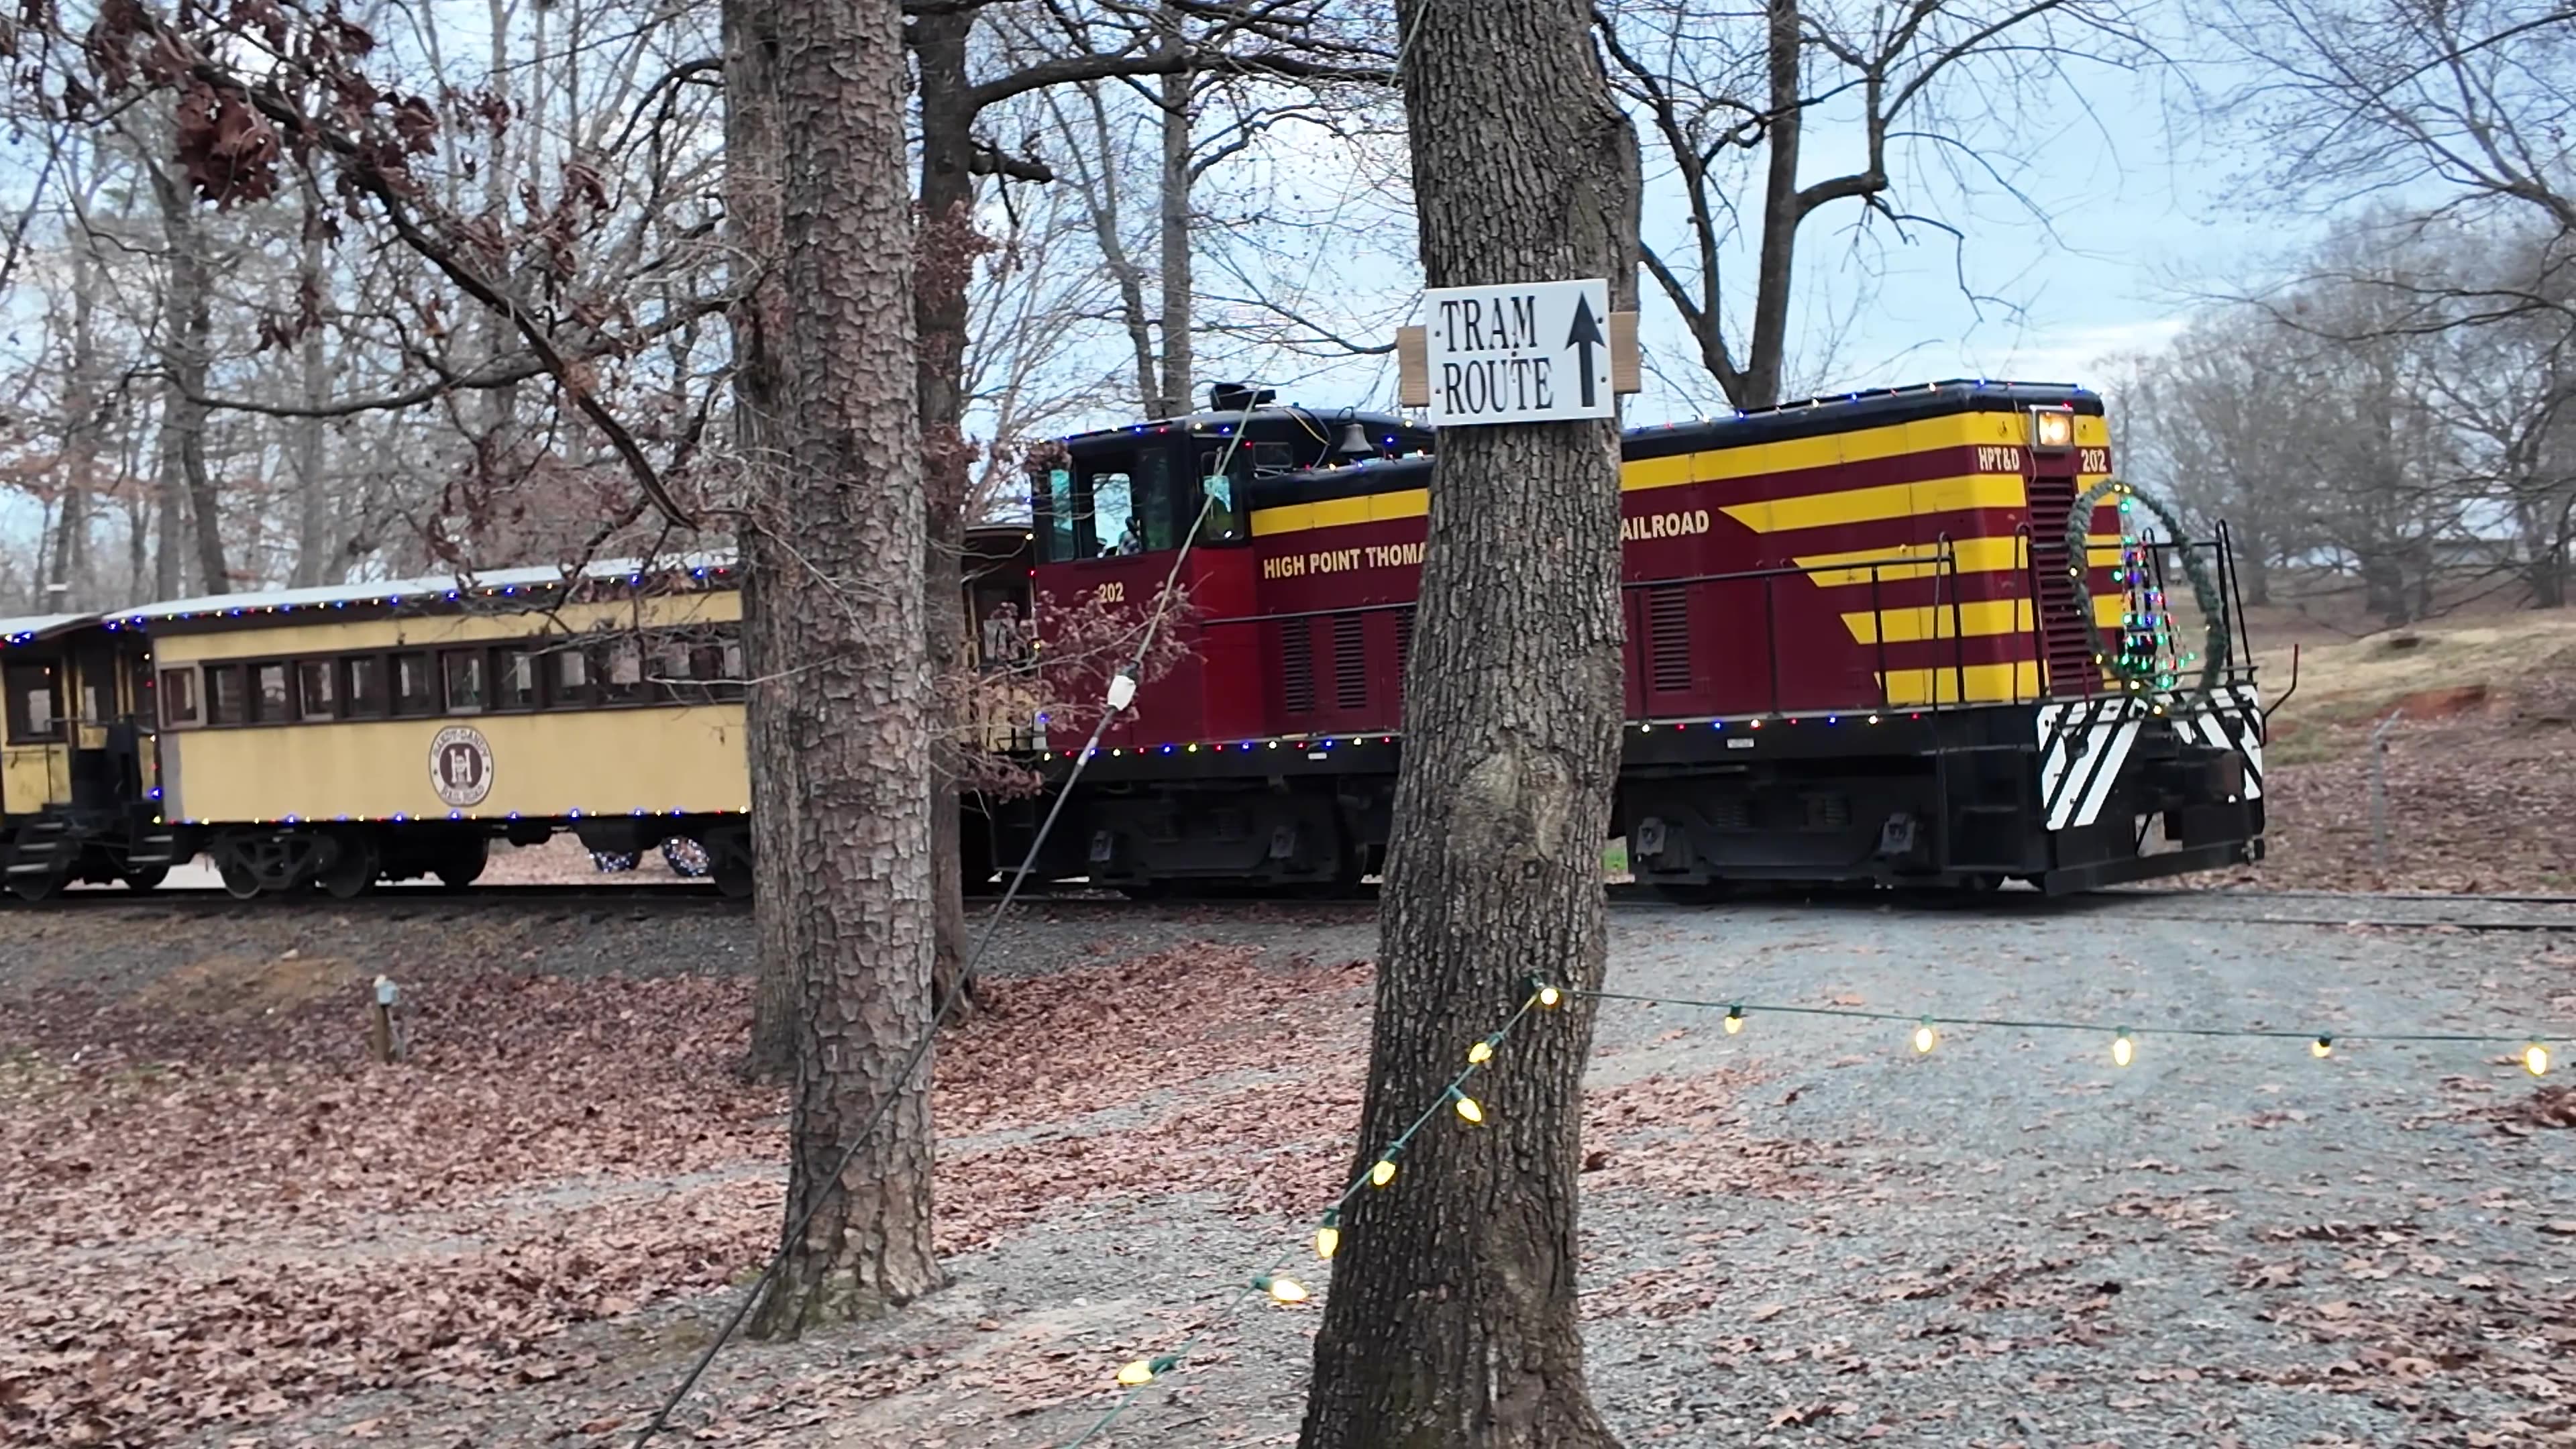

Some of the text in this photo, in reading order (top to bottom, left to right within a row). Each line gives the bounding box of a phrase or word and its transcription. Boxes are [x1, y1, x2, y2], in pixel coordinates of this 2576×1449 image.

[1440, 295, 1538, 352] TRAM
[1442, 357, 1553, 415] ROUTE
[1978, 446, 2020, 472] HPT&D
[2081, 448, 2108, 472] 202
[1263, 554, 1305, 580] HIGH
[1309, 548, 1361, 574] POINT
[1619, 509, 1709, 542] AILROAD
[1095, 581, 1125, 603] 202
